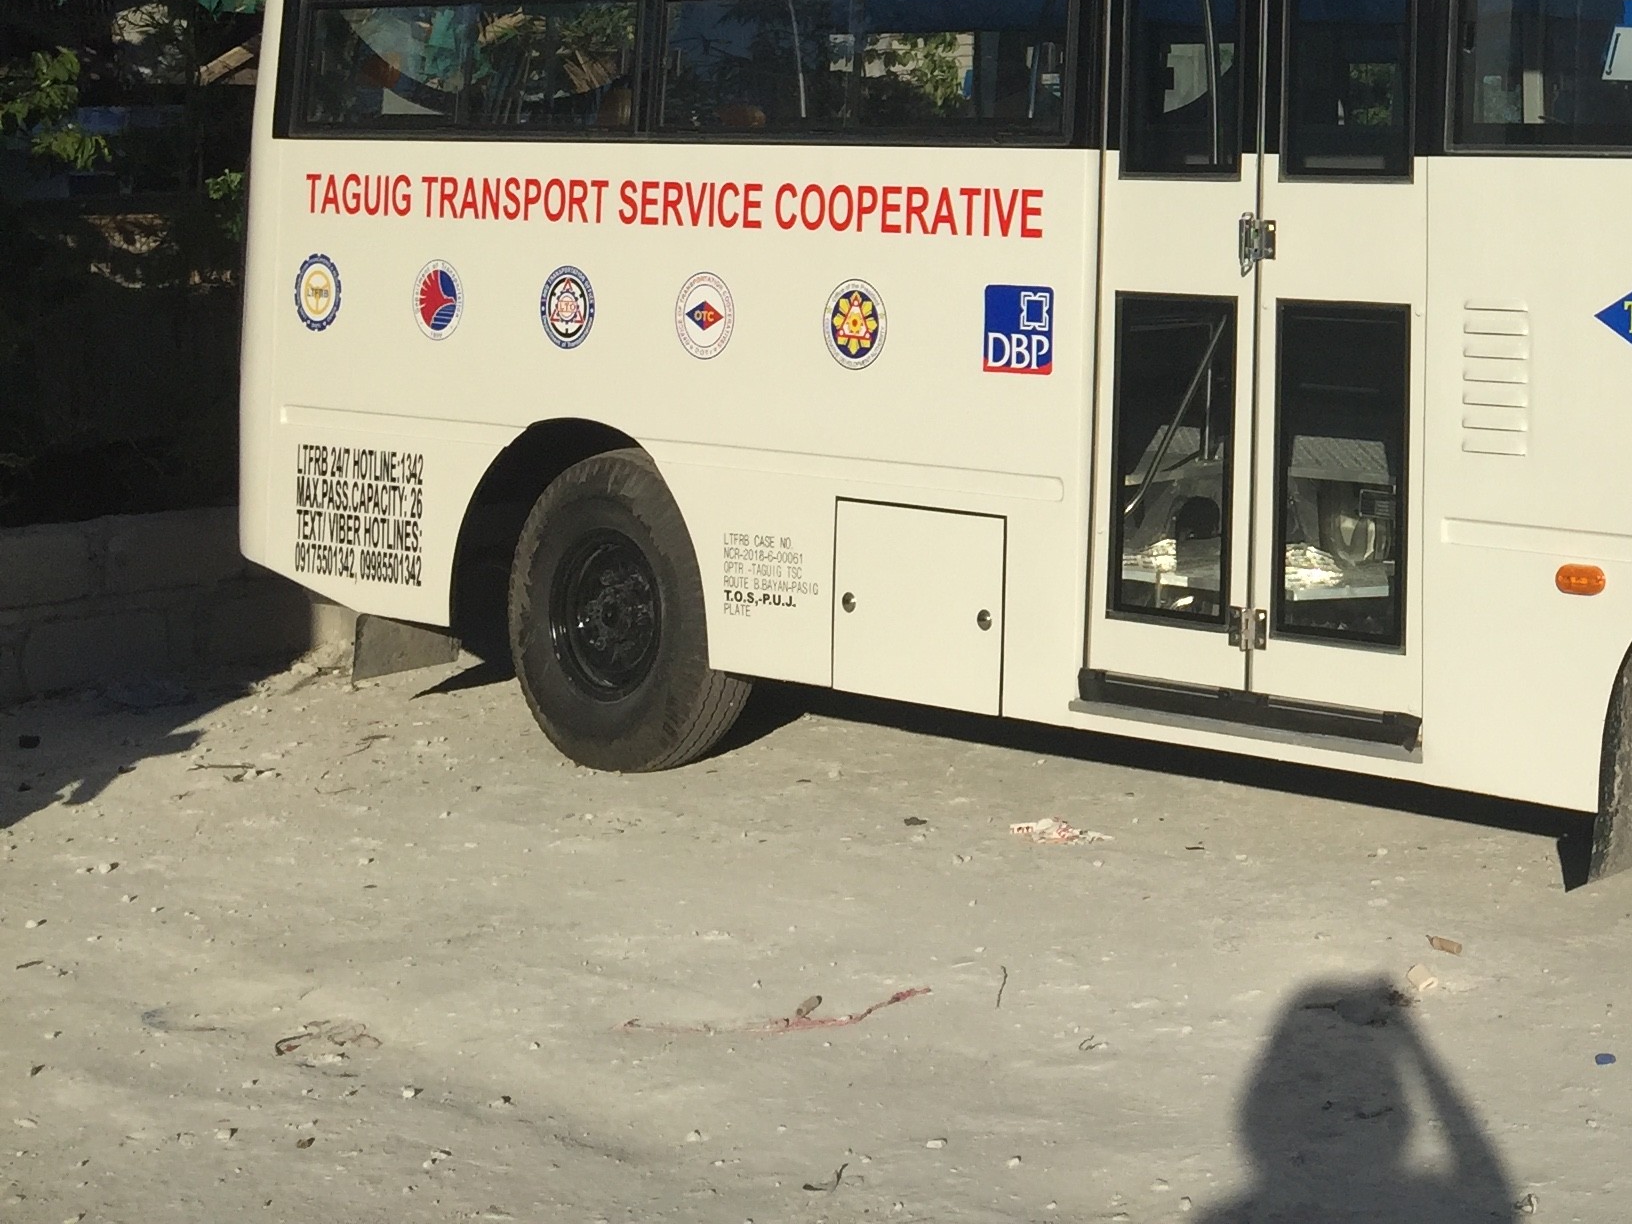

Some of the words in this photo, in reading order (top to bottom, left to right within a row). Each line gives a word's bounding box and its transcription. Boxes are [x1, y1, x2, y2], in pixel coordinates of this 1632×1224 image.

[306, 173, 411, 216] TAGUIG
[421, 176, 609, 223] TRANSPORT
[618, 180, 763, 229] SERVICE
[775, 183, 1043, 239] COOPERATIVE
[693, 310, 715, 322] OTC
[986, 331, 1050, 370] DBP
[297, 444, 328, 477] LTFRB
[330, 446, 351, 479] 24/7
[353, 448, 423, 485] HOTLINE:1342
[410, 487, 423, 519] 26
[296, 509, 326, 543] TEXT/
[328, 512, 361, 546] VIBER
[364, 516, 422, 554] HOTLINES:
[723, 533, 750, 546] LTFRB
[753, 534, 775, 548] CASE
[295, 541, 358, 585] 09175501342,
[359, 548, 422, 587] 09985501342
[723, 560, 744, 575] OPTR
[787, 566, 803, 580] TSC
[723, 575, 749, 589] ROUTE
[723, 603, 752, 617] PLATE
